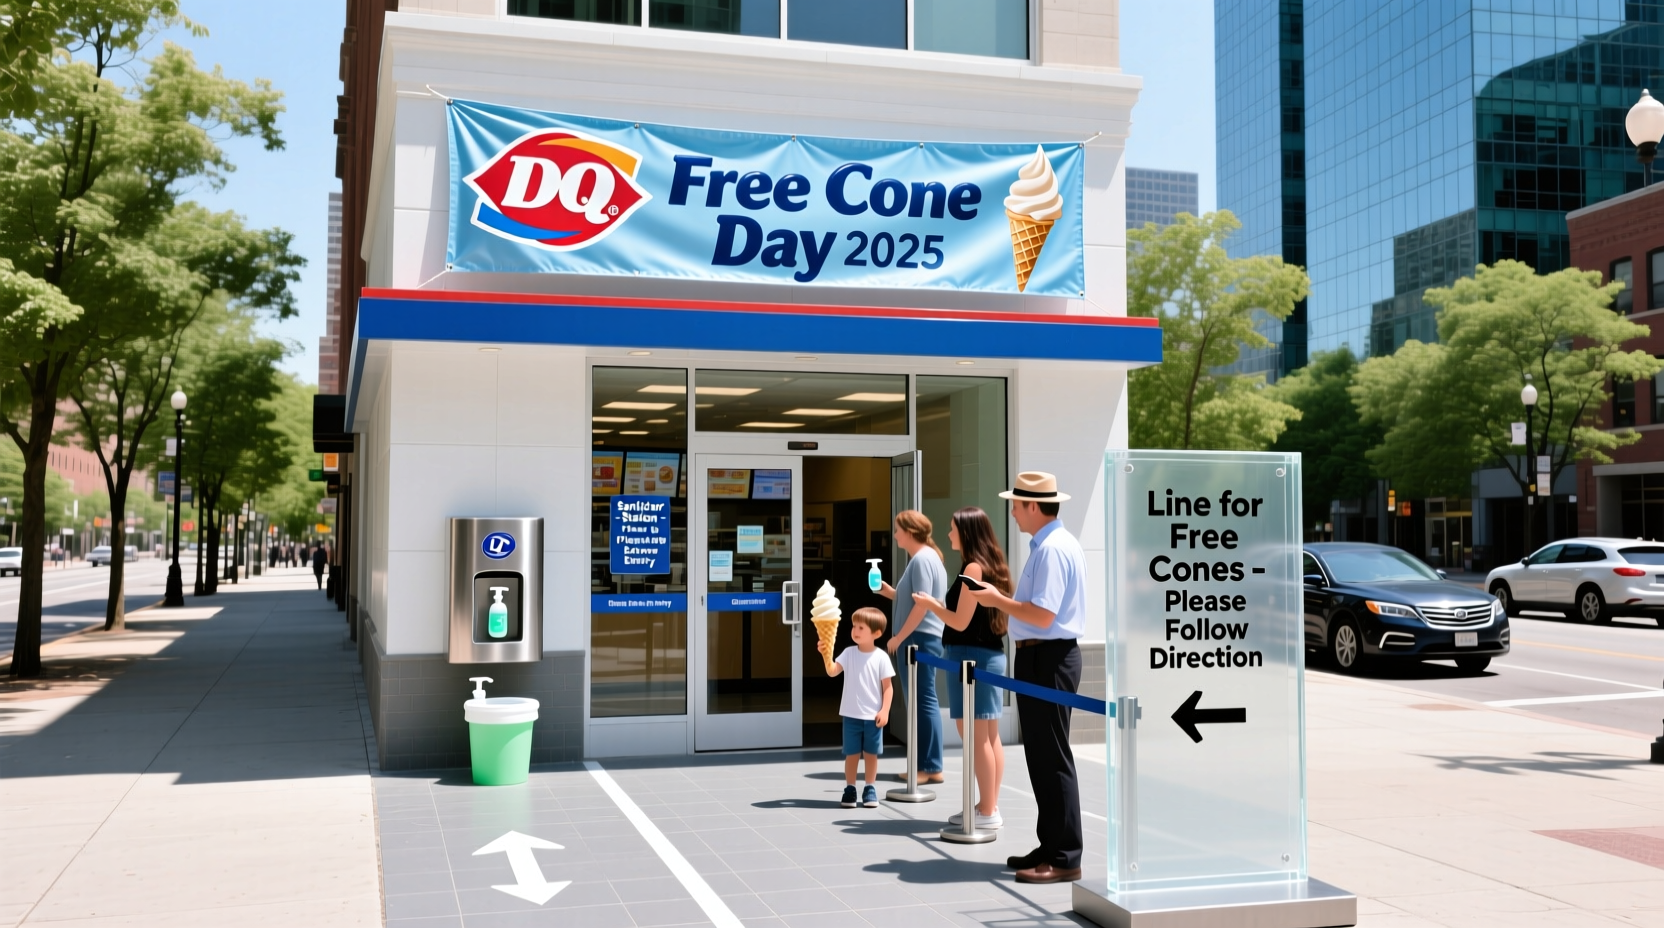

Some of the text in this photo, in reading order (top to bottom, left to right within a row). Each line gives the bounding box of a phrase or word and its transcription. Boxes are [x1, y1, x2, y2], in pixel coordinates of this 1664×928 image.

[668, 155, 982, 220] Free Cone
[711, 214, 944, 283] Day 2025
[1148, 488, 1264, 517] Line for
[1170, 523, 1239, 550] Free
[1149, 555, 1245, 582] Cones
[1165, 589, 1247, 612] Please
[1165, 617, 1249, 641] Follow
[1150, 645, 1263, 669] Direction
